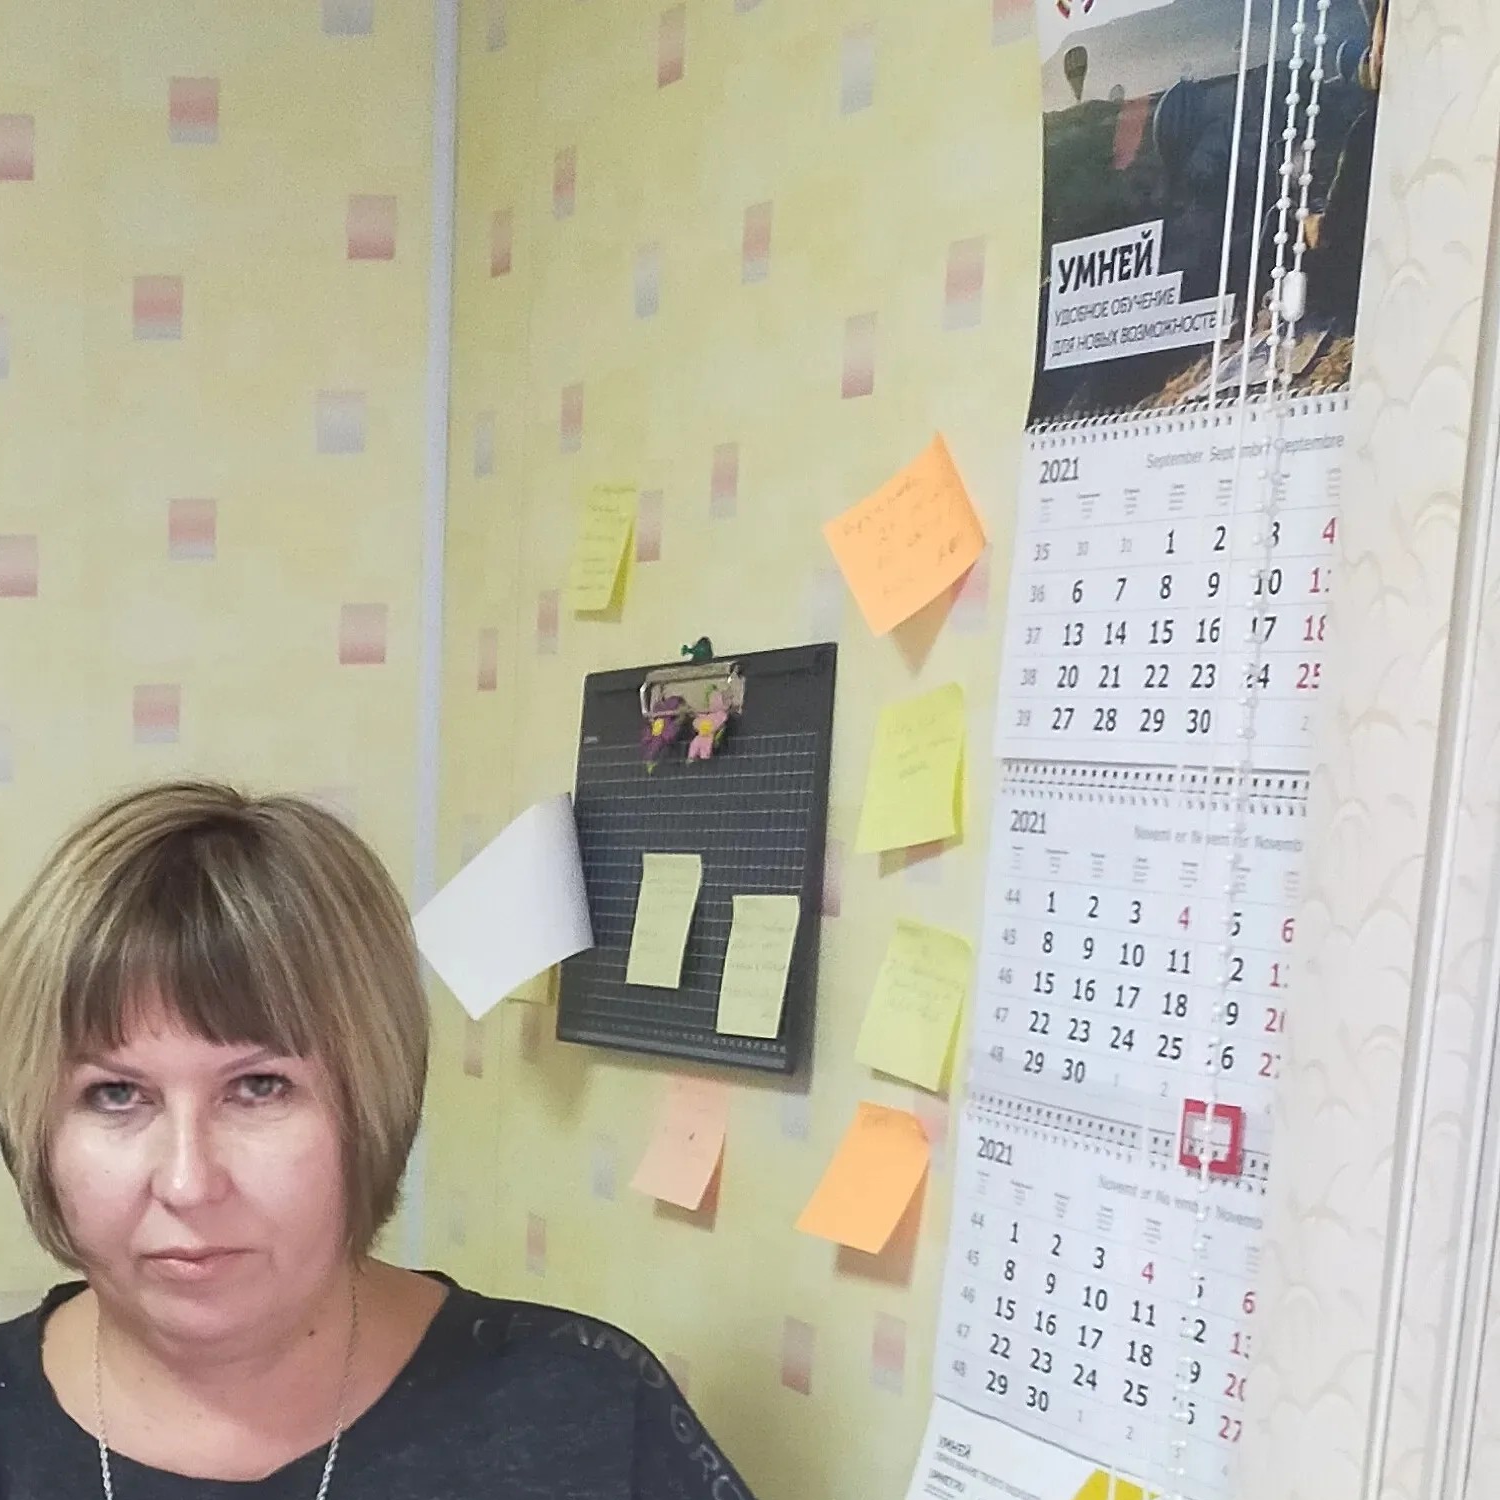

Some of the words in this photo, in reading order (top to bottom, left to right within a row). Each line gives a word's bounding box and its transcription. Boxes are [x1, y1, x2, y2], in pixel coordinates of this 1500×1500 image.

[1057, 229, 1155, 295] УМНЕЙ
[1054, 300, 1110, 326] УДОБНОЕ
[1111, 287, 1176, 316] ОБУЧЕНИЕ
[1051, 335, 1075, 357] ДЛЯ
[1077, 328, 1119, 350] НОВЫХ
[1038, 456, 1080, 485] 2021
[1034, 542, 1051, 561] 35
[1165, 528, 1176, 555] 1
[1213, 525, 1227, 552] 2
[1321, 516, 1337, 545] 4
[1029, 584, 1046, 603] 36
[1071, 578, 1085, 604] 6
[1115, 576, 1128, 602] 7
[1159, 574, 1173, 600] 8
[1207, 571, 1221, 598] 9
[1062, 622, 1085, 647] 13
[1104, 620, 1127, 645] 14
[1148, 619, 1175, 645] 15
[1195, 616, 1221, 644] 16
[1056, 664, 1080, 689] 20
[1098, 664, 1121, 689] 21
[1144, 663, 1170, 689] 22
[1190, 663, 1217, 689] 23
[1051, 706, 1076, 731] 27
[1092, 706, 1118, 732] 28
[1139, 707, 1165, 733] 29
[1186, 708, 1212, 734] 30
[1009, 809, 1047, 835] 2021
[1046, 890, 1057, 914] 1
[1087, 895, 1100, 919] 2
[1128, 900, 1142, 924] 3
[1177, 905, 1191, 931] 4
[1281, 917, 1296, 944] 6
[1041, 930, 1055, 954] 8
[1082, 936, 1095, 960] 9
[1118, 941, 1145, 968] 10
[1166, 948, 1191, 975] 11
[1033, 970, 1056, 995] 15
[1072, 977, 1096, 1002] 16
[1114, 984, 1141, 1009] 17
[1161, 991, 1189, 1018] 18
[1028, 1009, 1051, 1035] 22
[1067, 1017, 1091, 1043] 23
[1109, 1025, 1136, 1052] 24
[1157, 1033, 1184, 1061] 25
[1023, 1049, 1046, 1075] 29
[1061, 1057, 1086, 1084] 30
[977, 1135, 1014, 1166] 2021
[1009, 1221, 1019, 1244] 1
[1051, 1233, 1063, 1257] 2
[1092, 1246, 1106, 1270] 3
[1140, 1261, 1155, 1284] 4
[1242, 1290, 1256, 1315] 6
[1003, 1259, 1016, 1281] 8
[1044, 1272, 1057, 1295] 9
[1082, 1285, 1108, 1312] 10
[1130, 1299, 1156, 1328] 11
[994, 1295, 1017, 1321] 15
[1033, 1310, 1058, 1337] 16
[1077, 1325, 1103, 1350] 17
[1126, 1340, 1154, 1368] 18
[985, 1369, 1009, 1396] 29
[1025, 1385, 1050, 1413] 30
[989, 1332, 1011, 1360] 22
[1029, 1347, 1053, 1374] 23
[1072, 1363, 1099, 1391] 24
[1122, 1379, 1149, 1408] 25
[1217, 1414, 1243, 1443] 27
